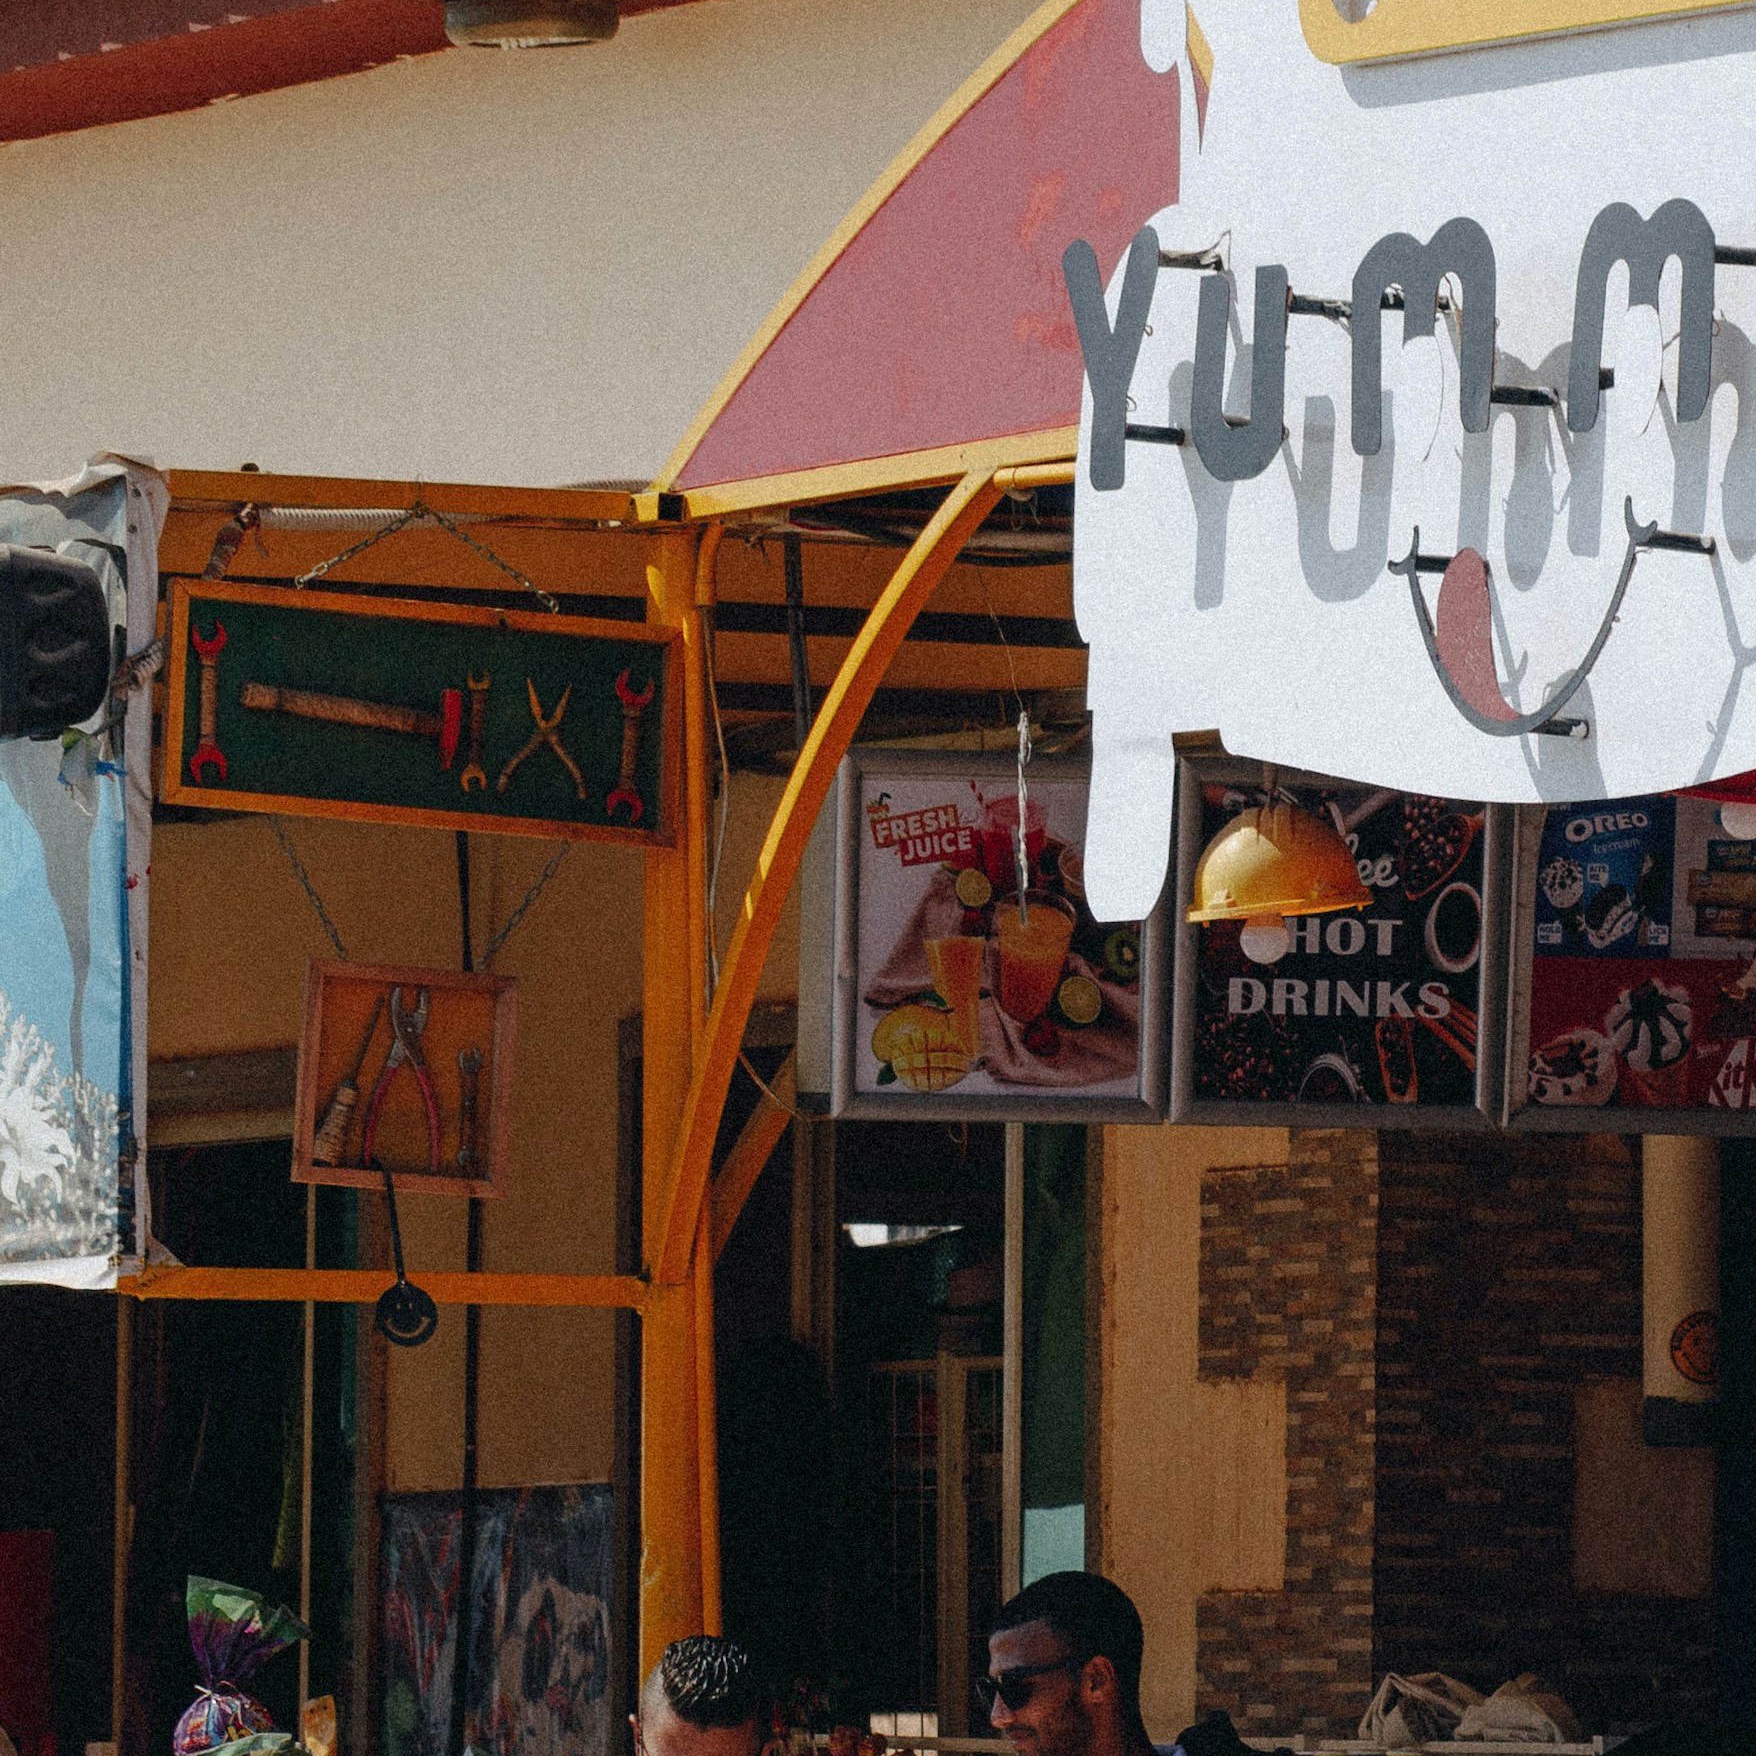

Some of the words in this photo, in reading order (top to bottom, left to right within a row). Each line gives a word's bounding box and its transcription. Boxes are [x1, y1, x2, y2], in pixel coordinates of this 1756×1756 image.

[875, 806, 956, 844] FRESH
[1564, 811, 1649, 843] OREO
[904, 828, 973, 861] JUICE
[1284, 916, 1403, 956] HOT
[1228, 976, 1451, 1019] DRINKS
